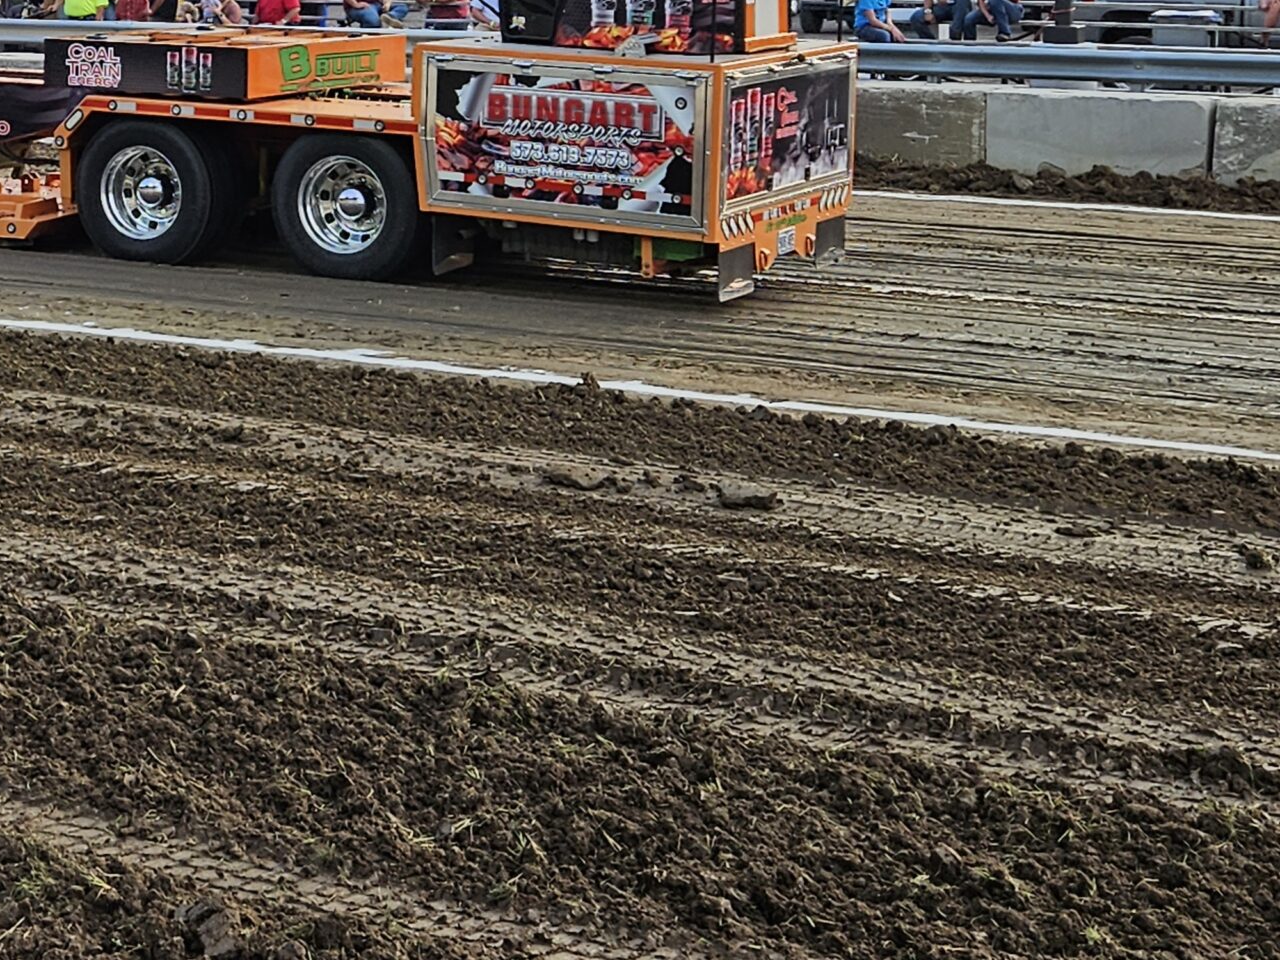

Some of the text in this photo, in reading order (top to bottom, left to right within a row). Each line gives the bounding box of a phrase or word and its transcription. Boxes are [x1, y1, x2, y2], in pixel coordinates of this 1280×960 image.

[67, 42, 120, 63] COAL
[279, 44, 381, 82] B BUILT
[65, 58, 122, 79] TRAIN
[67, 74, 120, 89] ENERGY
[487, 91, 659, 132] BUNGART
[501, 118, 642, 147] MOTORSPORTS
